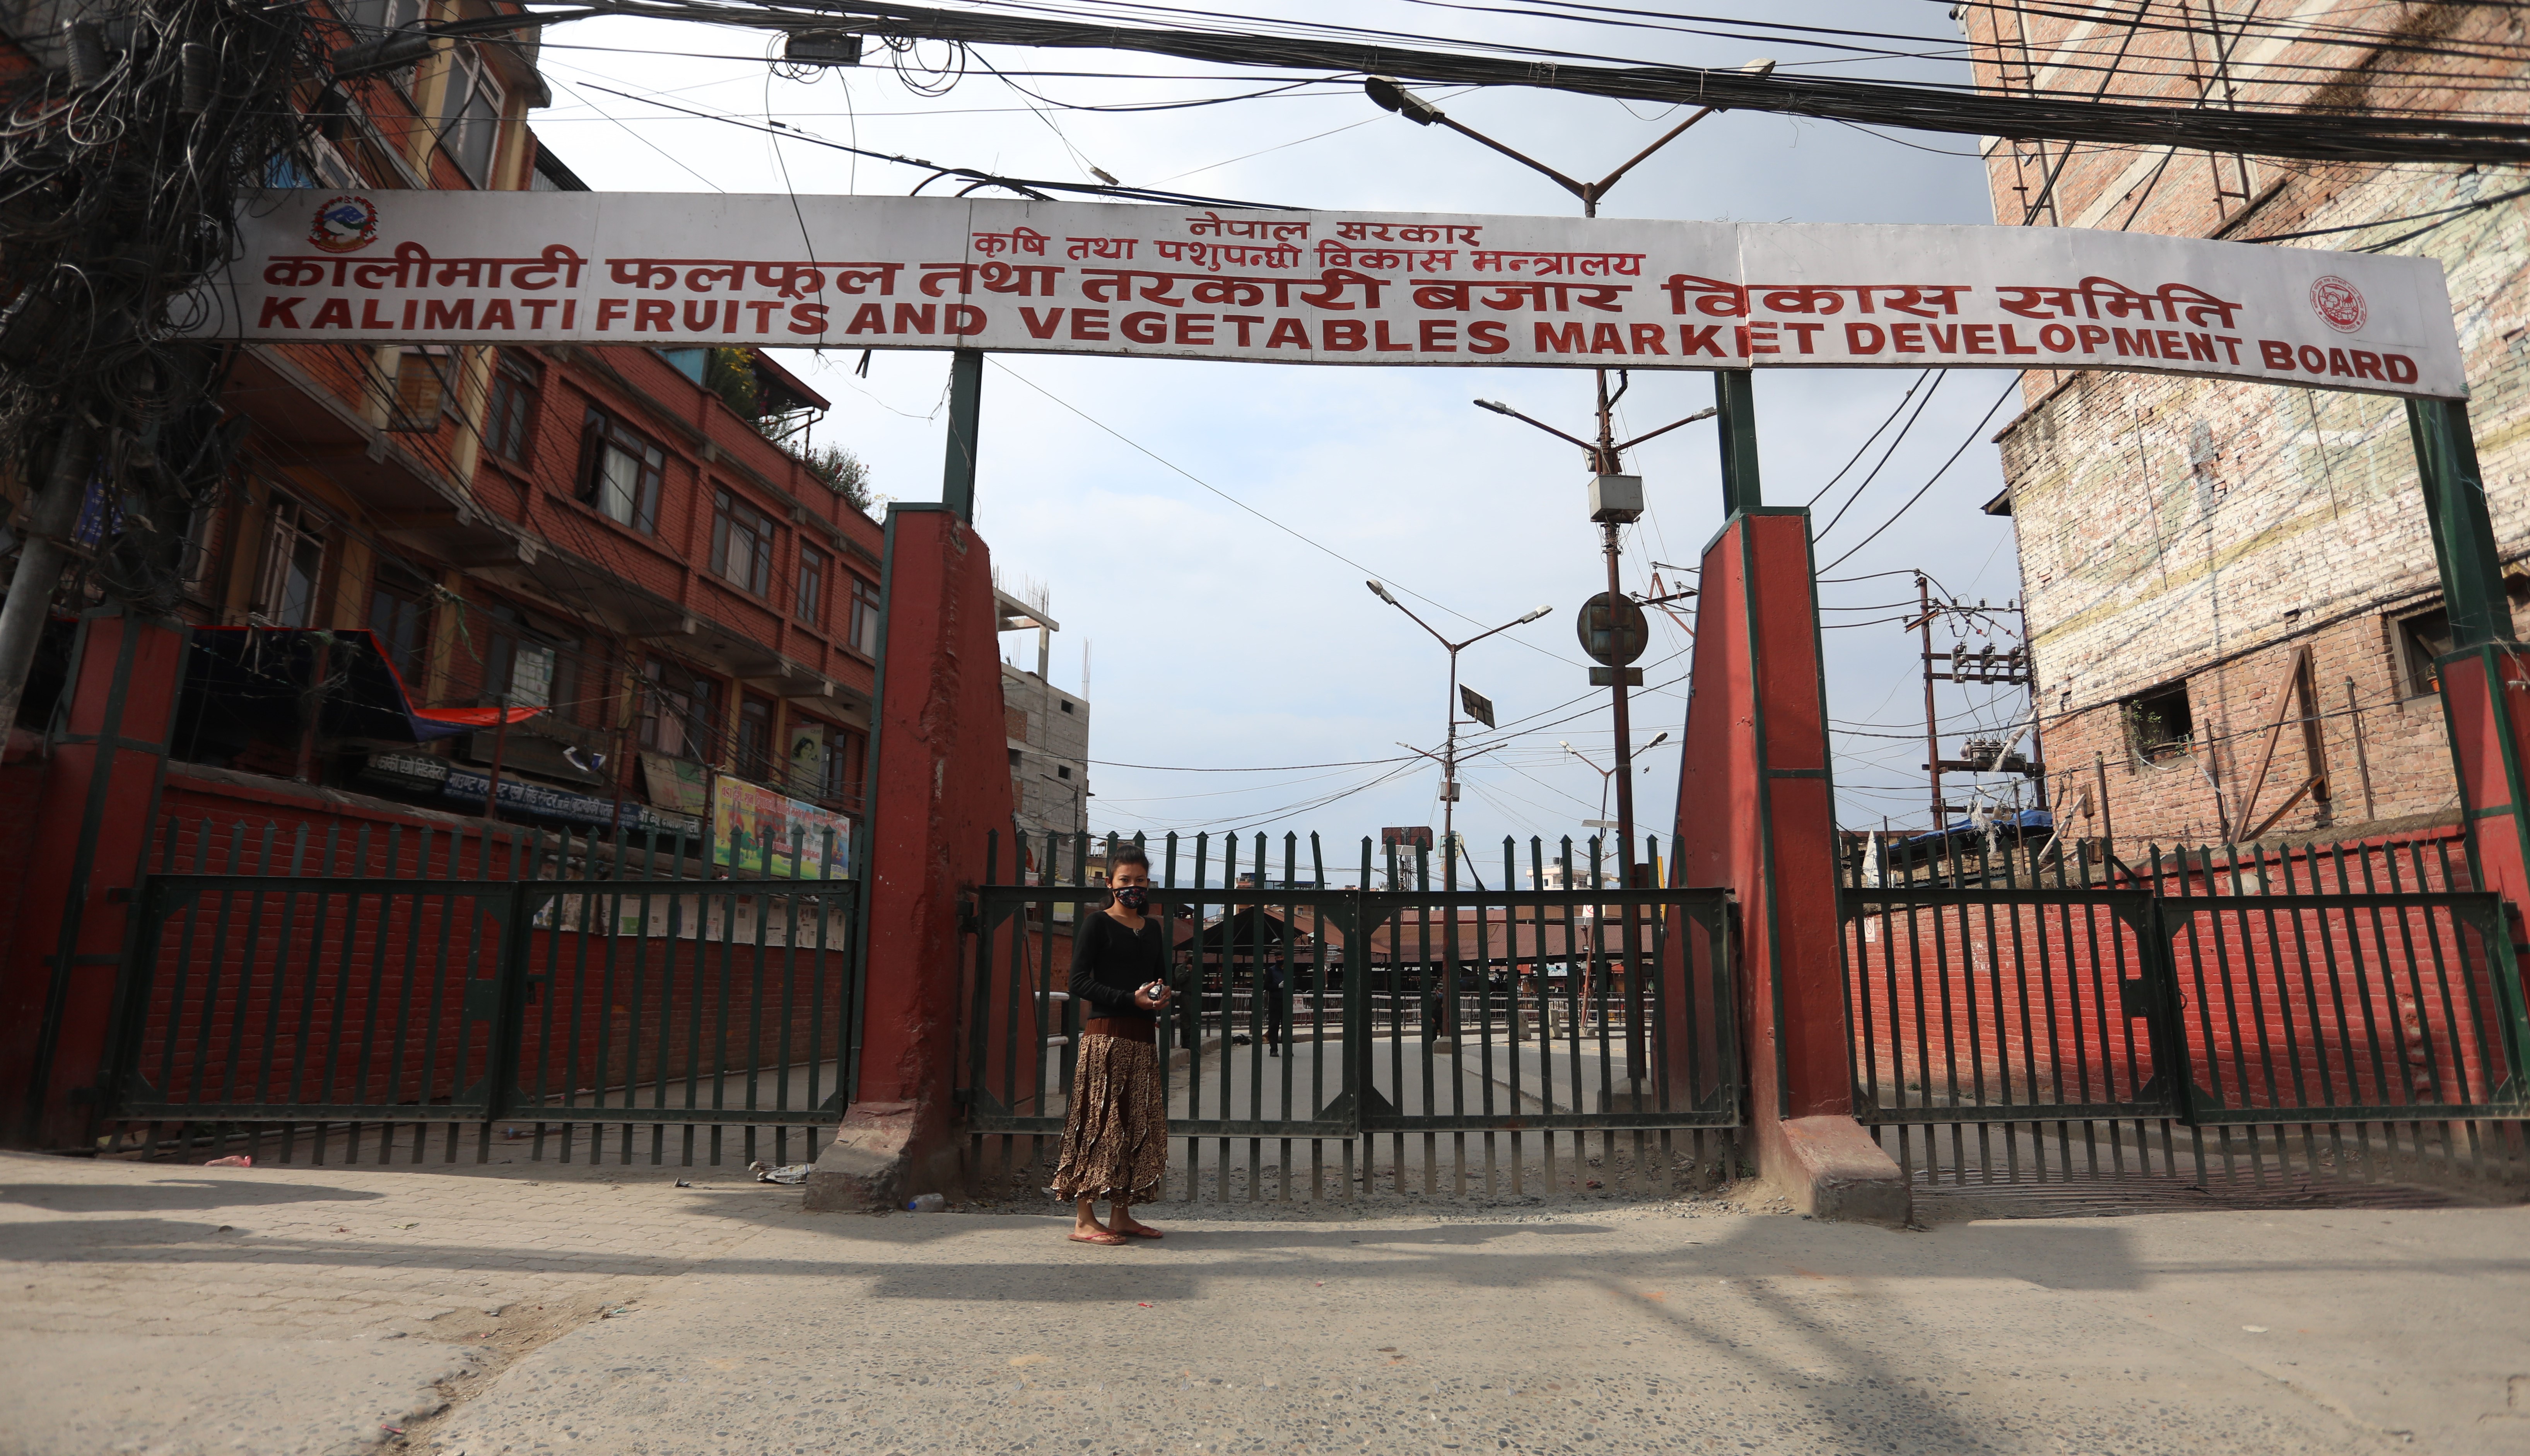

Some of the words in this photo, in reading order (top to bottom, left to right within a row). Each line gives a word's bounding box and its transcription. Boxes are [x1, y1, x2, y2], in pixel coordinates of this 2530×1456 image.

[972, 227, 1051, 258] कृषि
[1066, 237, 1139, 260] तथा
[1154, 241, 1302, 271] पशुपन्छी
[1314, 239, 1459, 273] विकास
[1471, 251, 1646, 276] मन्त्रालय
[1187, 212, 1310, 242] नेपाल
[1337, 222, 1482, 246] सरकार
[263, 241, 588, 290] कालीमाटी
[606, 259, 904, 300] फलफूल
[920, 261, 1065, 297] तथा
[1081, 268, 1391, 310] तरकारी
[1410, 279, 1633, 312] बजार
[1661, 274, 1972, 318] विकास
[1996, 276, 2243, 328] समिति
[260, 297, 576, 329] KALIMATI
[596, 299, 829, 334] FRUITS
[846, 303, 987, 335] AND
[1019, 307, 1510, 353] VEGETABLES
[1535, 321, 1824, 358] MARKET
[1845, 323, 2243, 365] DEVELOPMENT
[2259, 340, 2418, 384] BOARD
